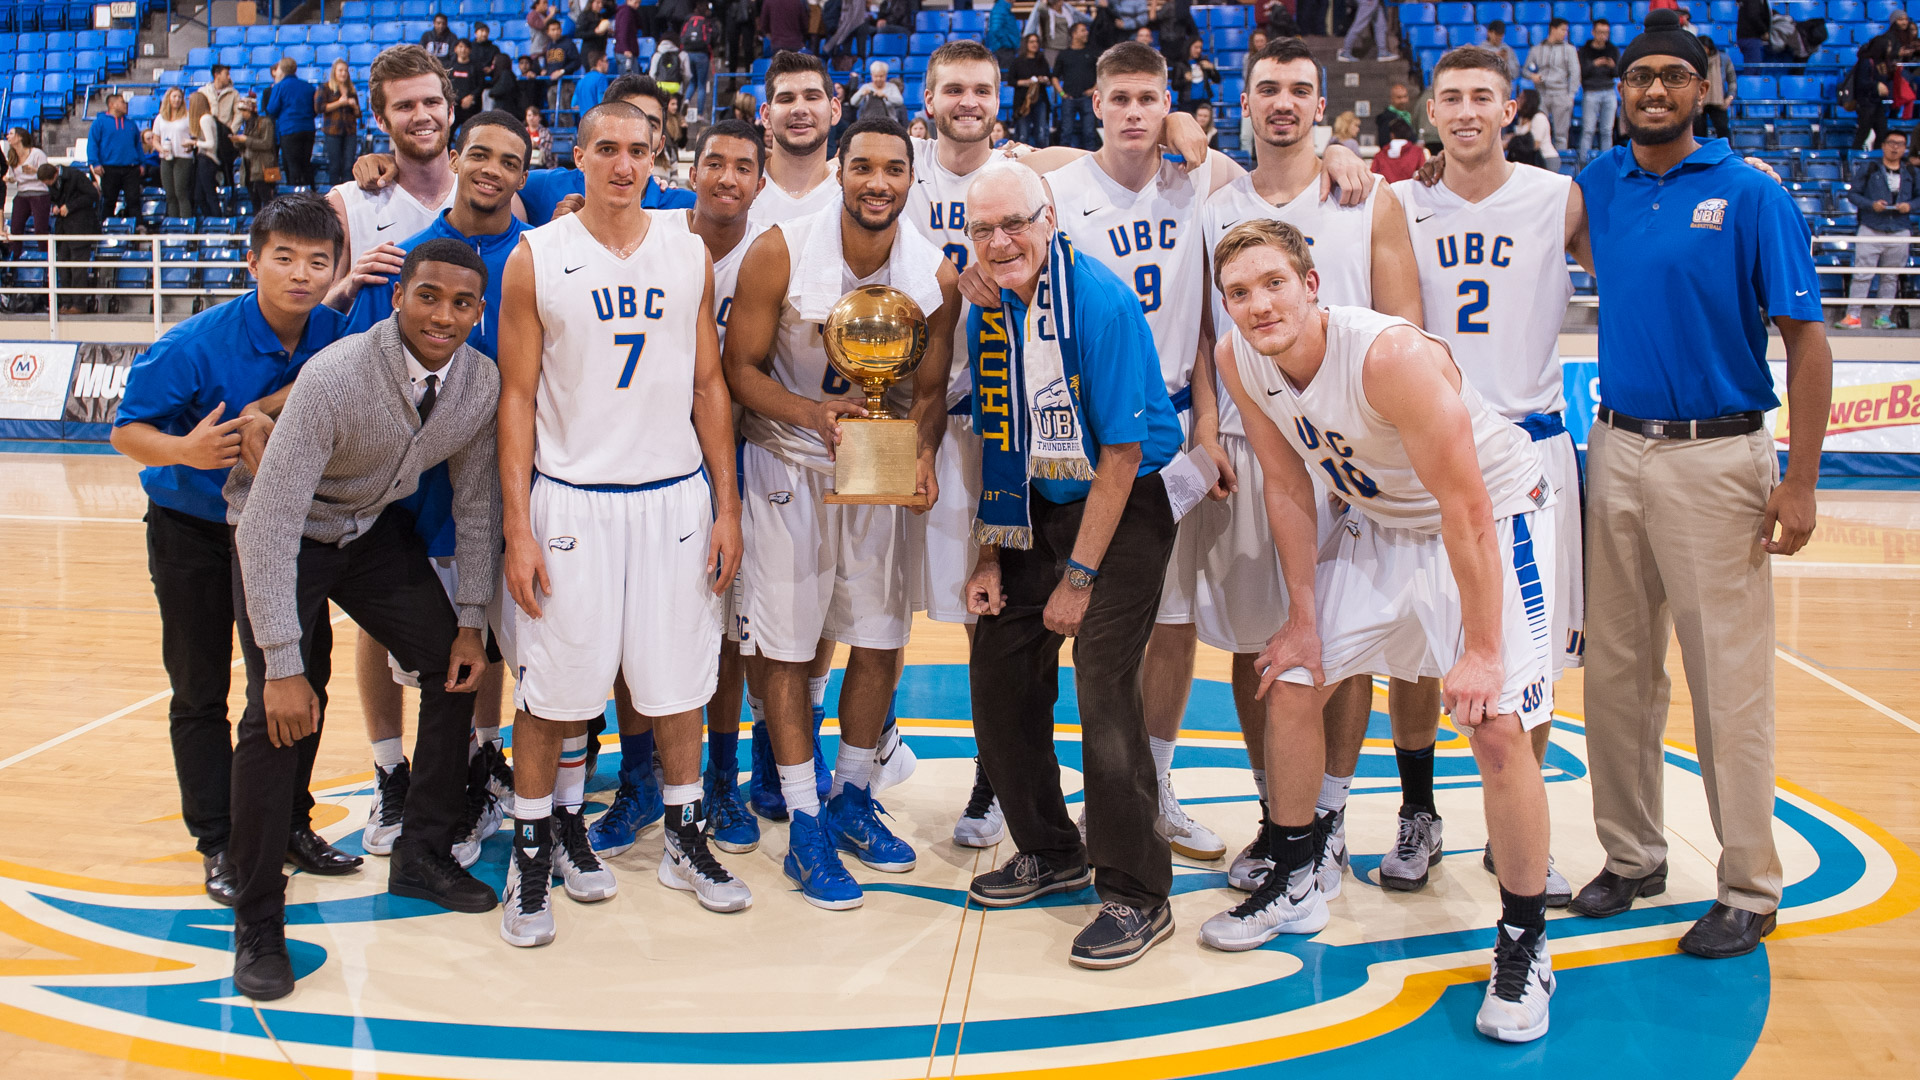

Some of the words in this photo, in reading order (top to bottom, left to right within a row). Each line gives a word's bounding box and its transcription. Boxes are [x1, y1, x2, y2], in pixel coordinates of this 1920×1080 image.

[930, 200, 966, 231] UB
[1689, 222, 1723, 231] BASKETBALL
[1692, 207, 1726, 225] UBC
[1106, 217, 1177, 258] UBC
[1435, 231, 1514, 269] UBC
[590, 285, 666, 322] UBC
[1133, 263, 1162, 315] 9
[1456, 278, 1490, 335] 2
[613, 332, 647, 390] 7
[1033, 409, 1078, 439] UB
[1787, 384, 1920, 430] werBa
[1293, 415, 1354, 459] UC
